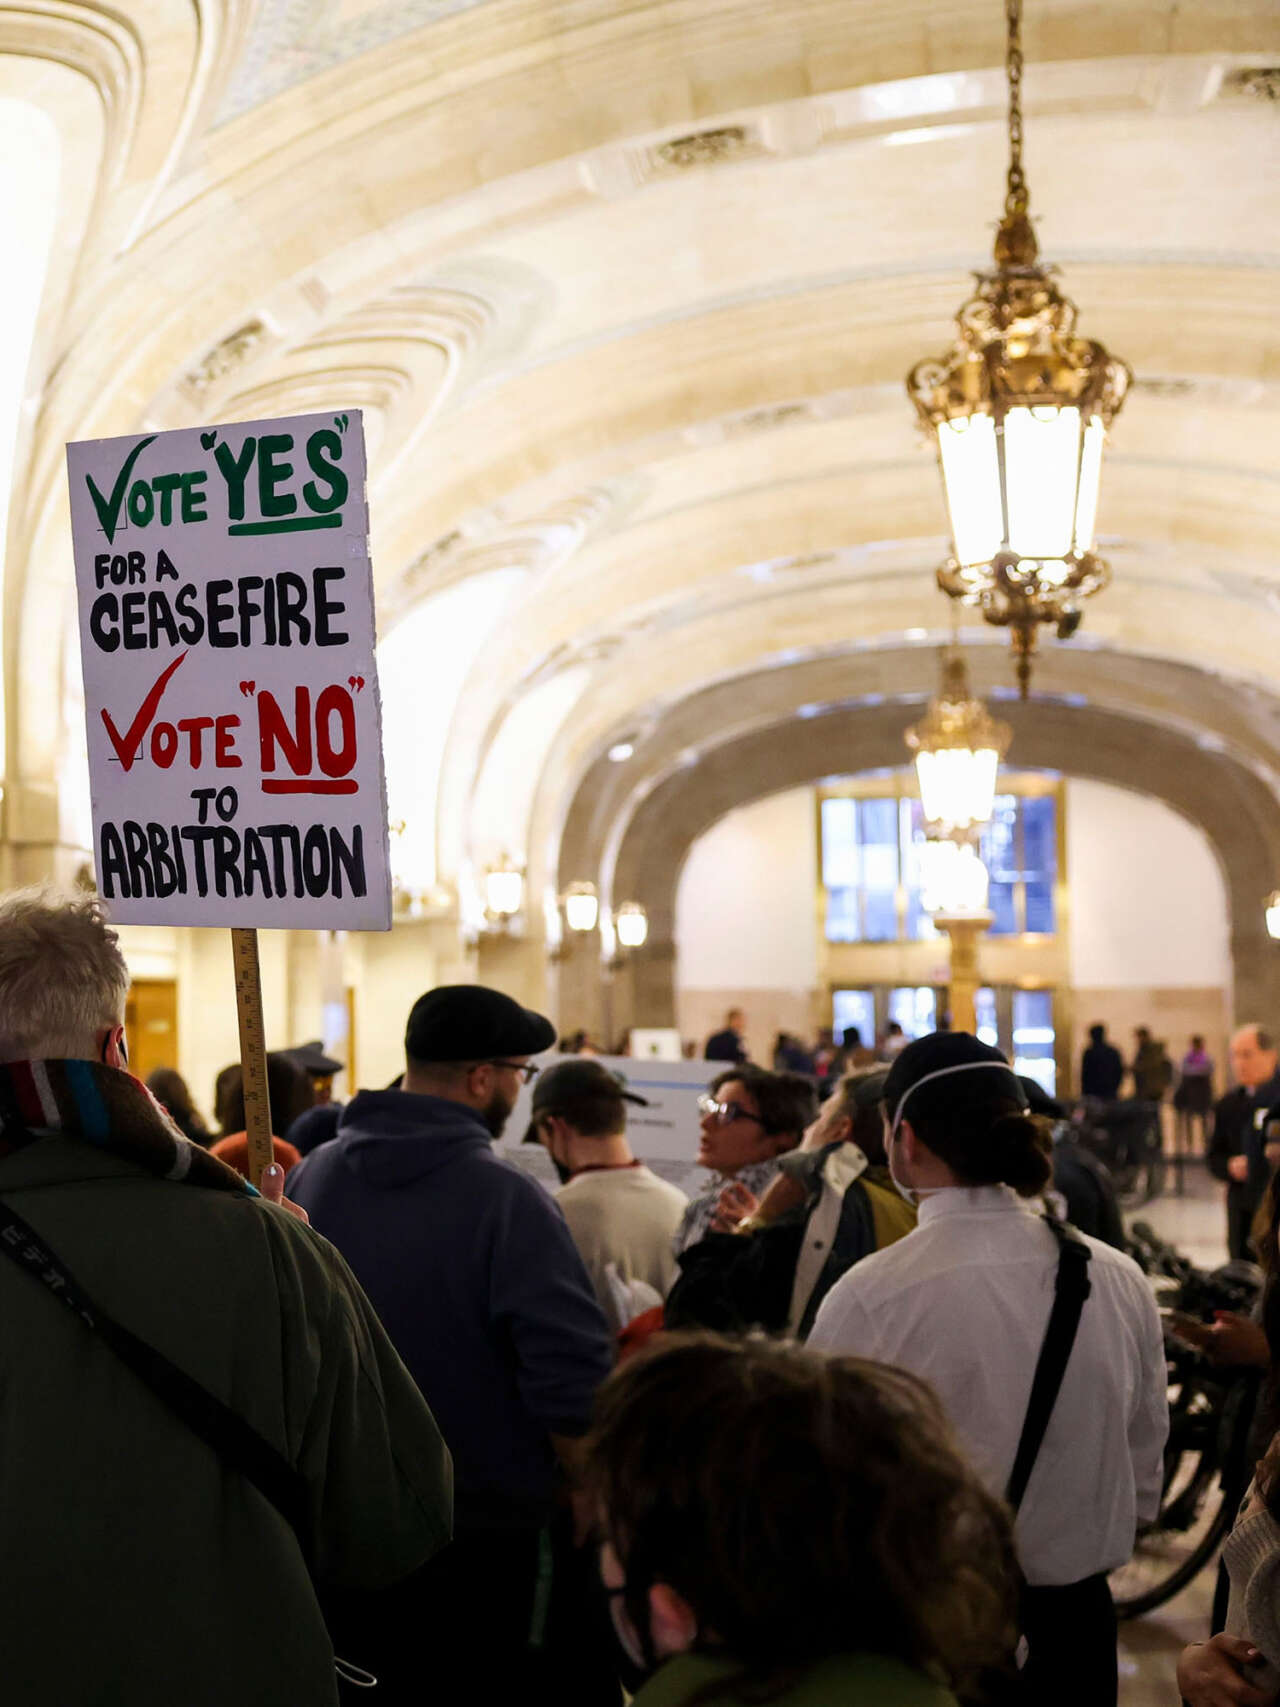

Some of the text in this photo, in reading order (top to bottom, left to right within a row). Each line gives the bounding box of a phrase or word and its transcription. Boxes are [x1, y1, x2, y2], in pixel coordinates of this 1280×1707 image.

[86, 435, 207, 545] VOTE
[90, 567, 349, 652] CEASEFIRE
[95, 550, 179, 589] FOR A
[100, 650, 242, 771] VOTE
[191, 786, 238, 823] TO
[101, 819, 367, 899] ARBITRATION
